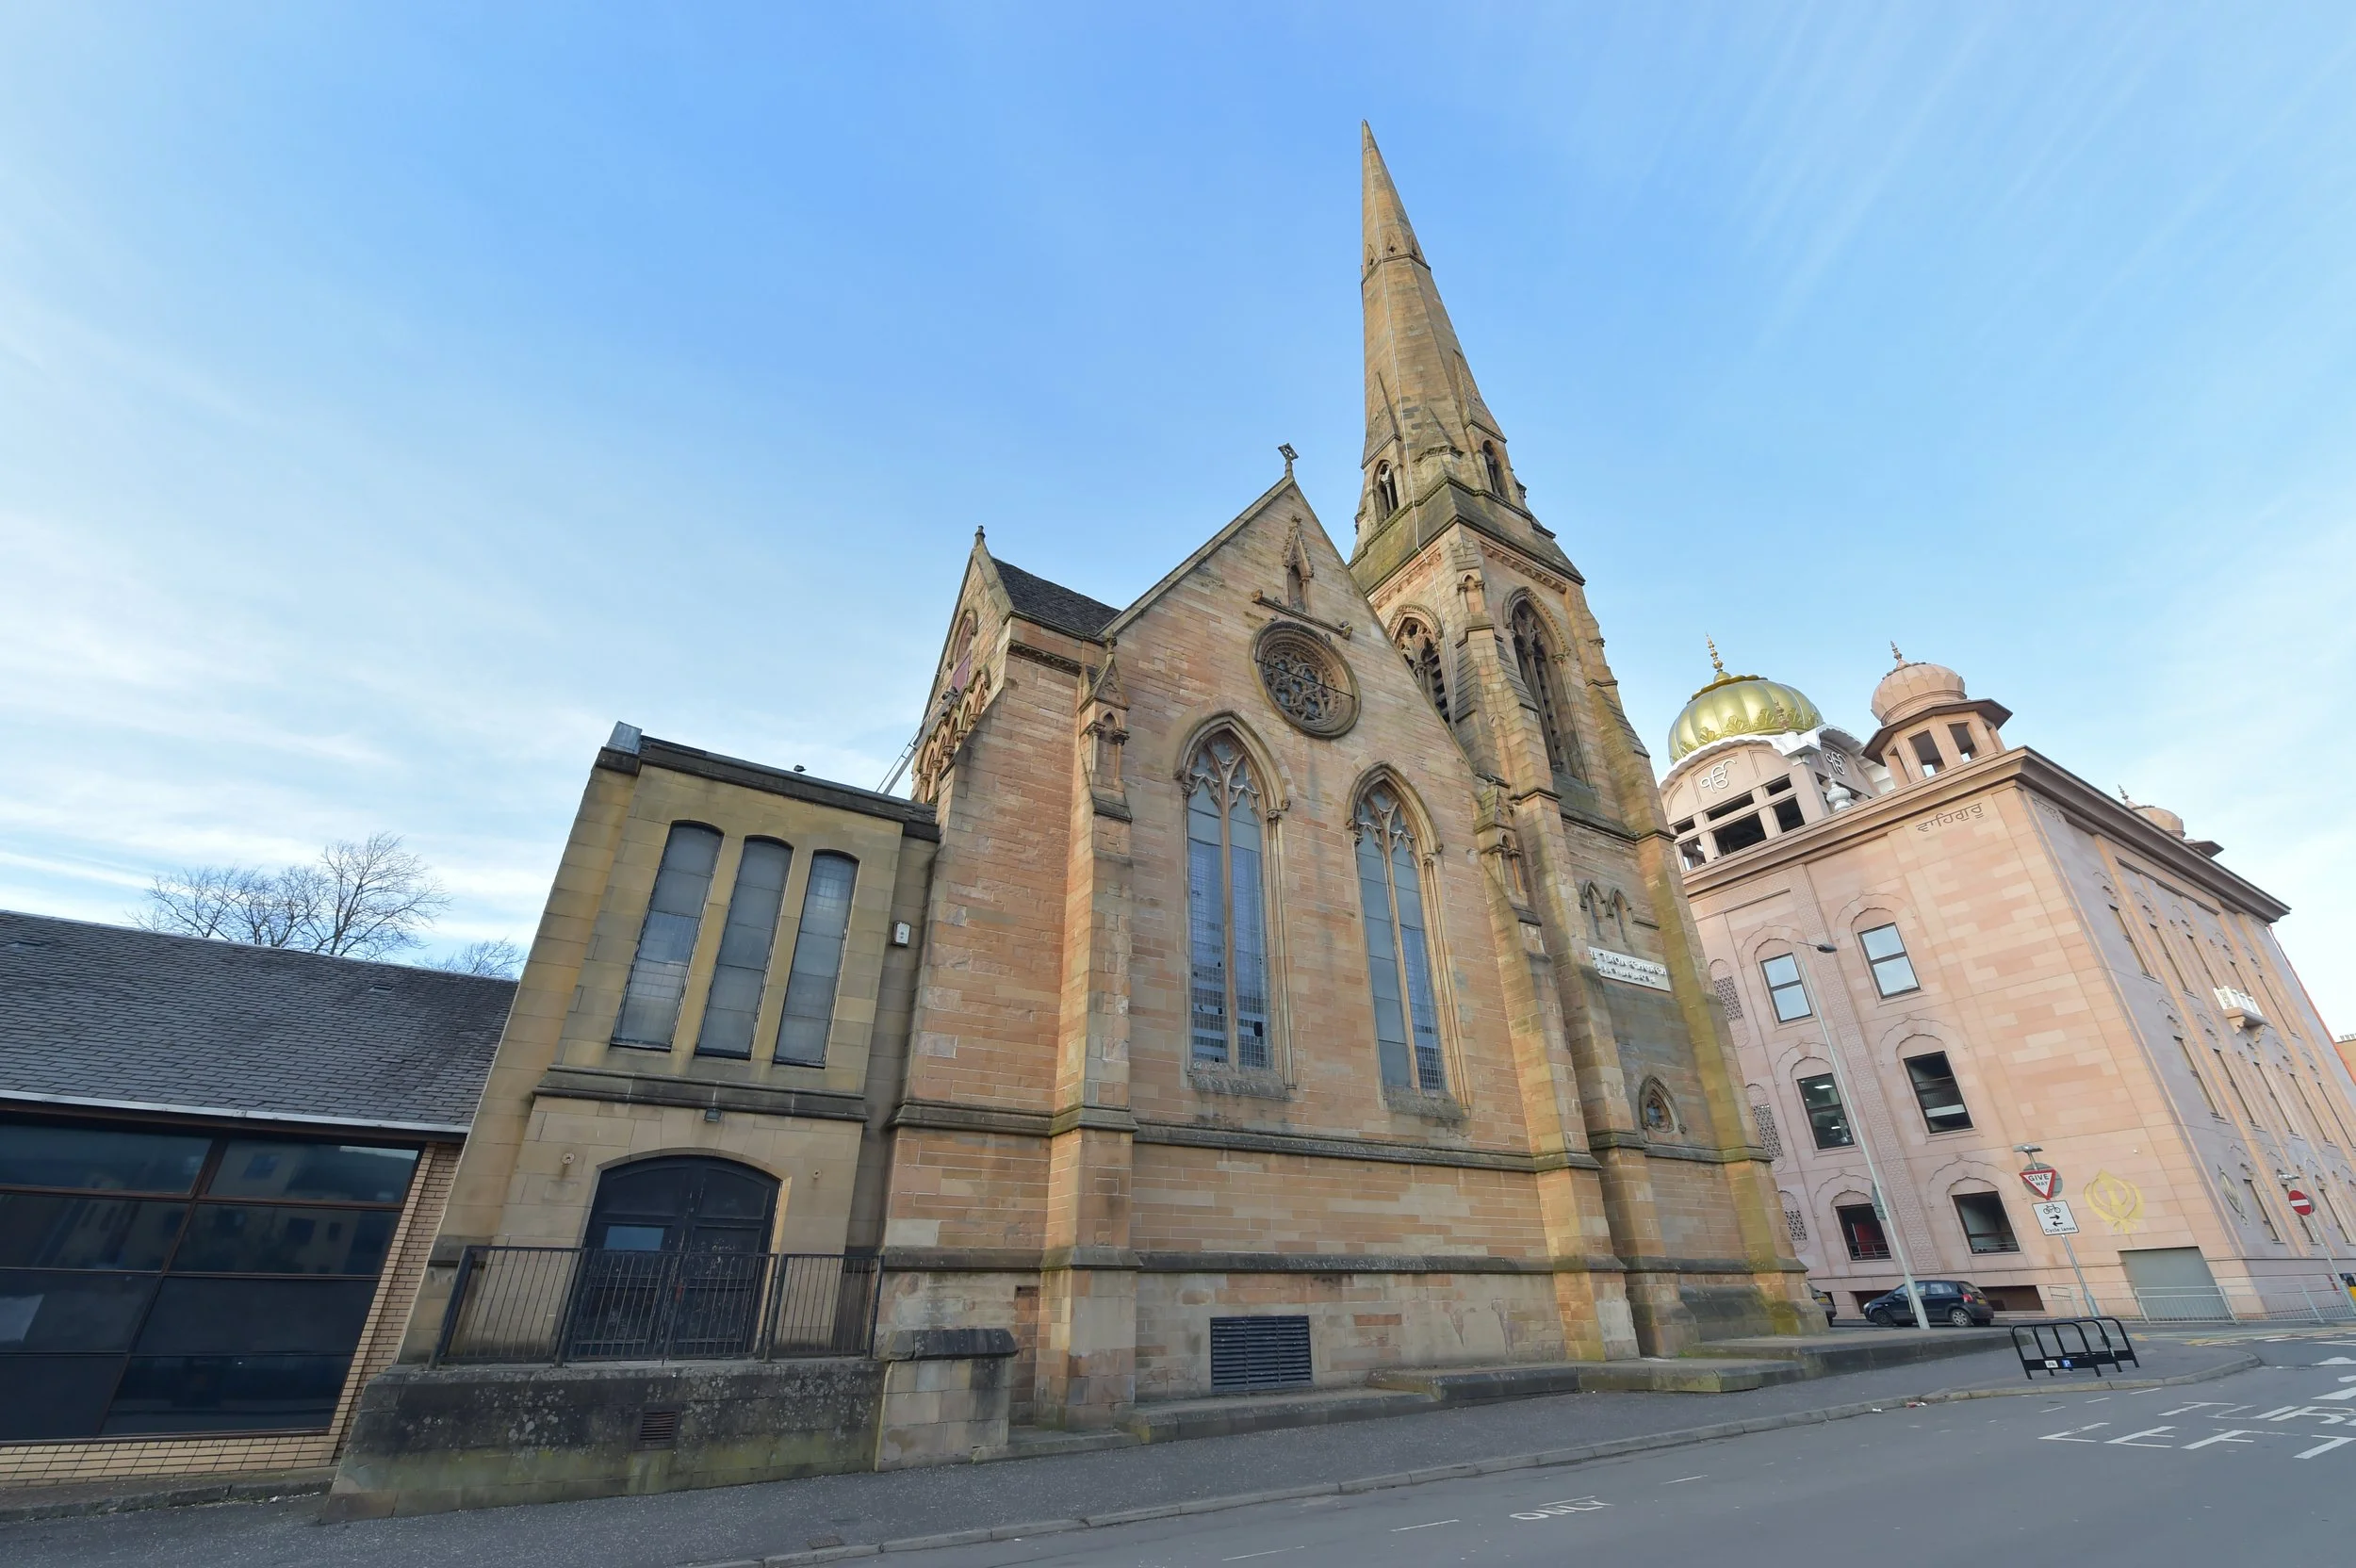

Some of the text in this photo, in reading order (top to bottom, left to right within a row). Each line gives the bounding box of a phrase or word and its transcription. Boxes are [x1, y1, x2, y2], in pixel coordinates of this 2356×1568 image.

[1915, 802, 1985, 833] ਵਾਹਿਗੁਰੂ
[2028, 1173, 2050, 1182] GIVE
[2157, 1401, 2356, 1427] TUR
[2037, 1422, 2356, 1460] LEFT
[1509, 1495, 1614, 1520] ONLY
